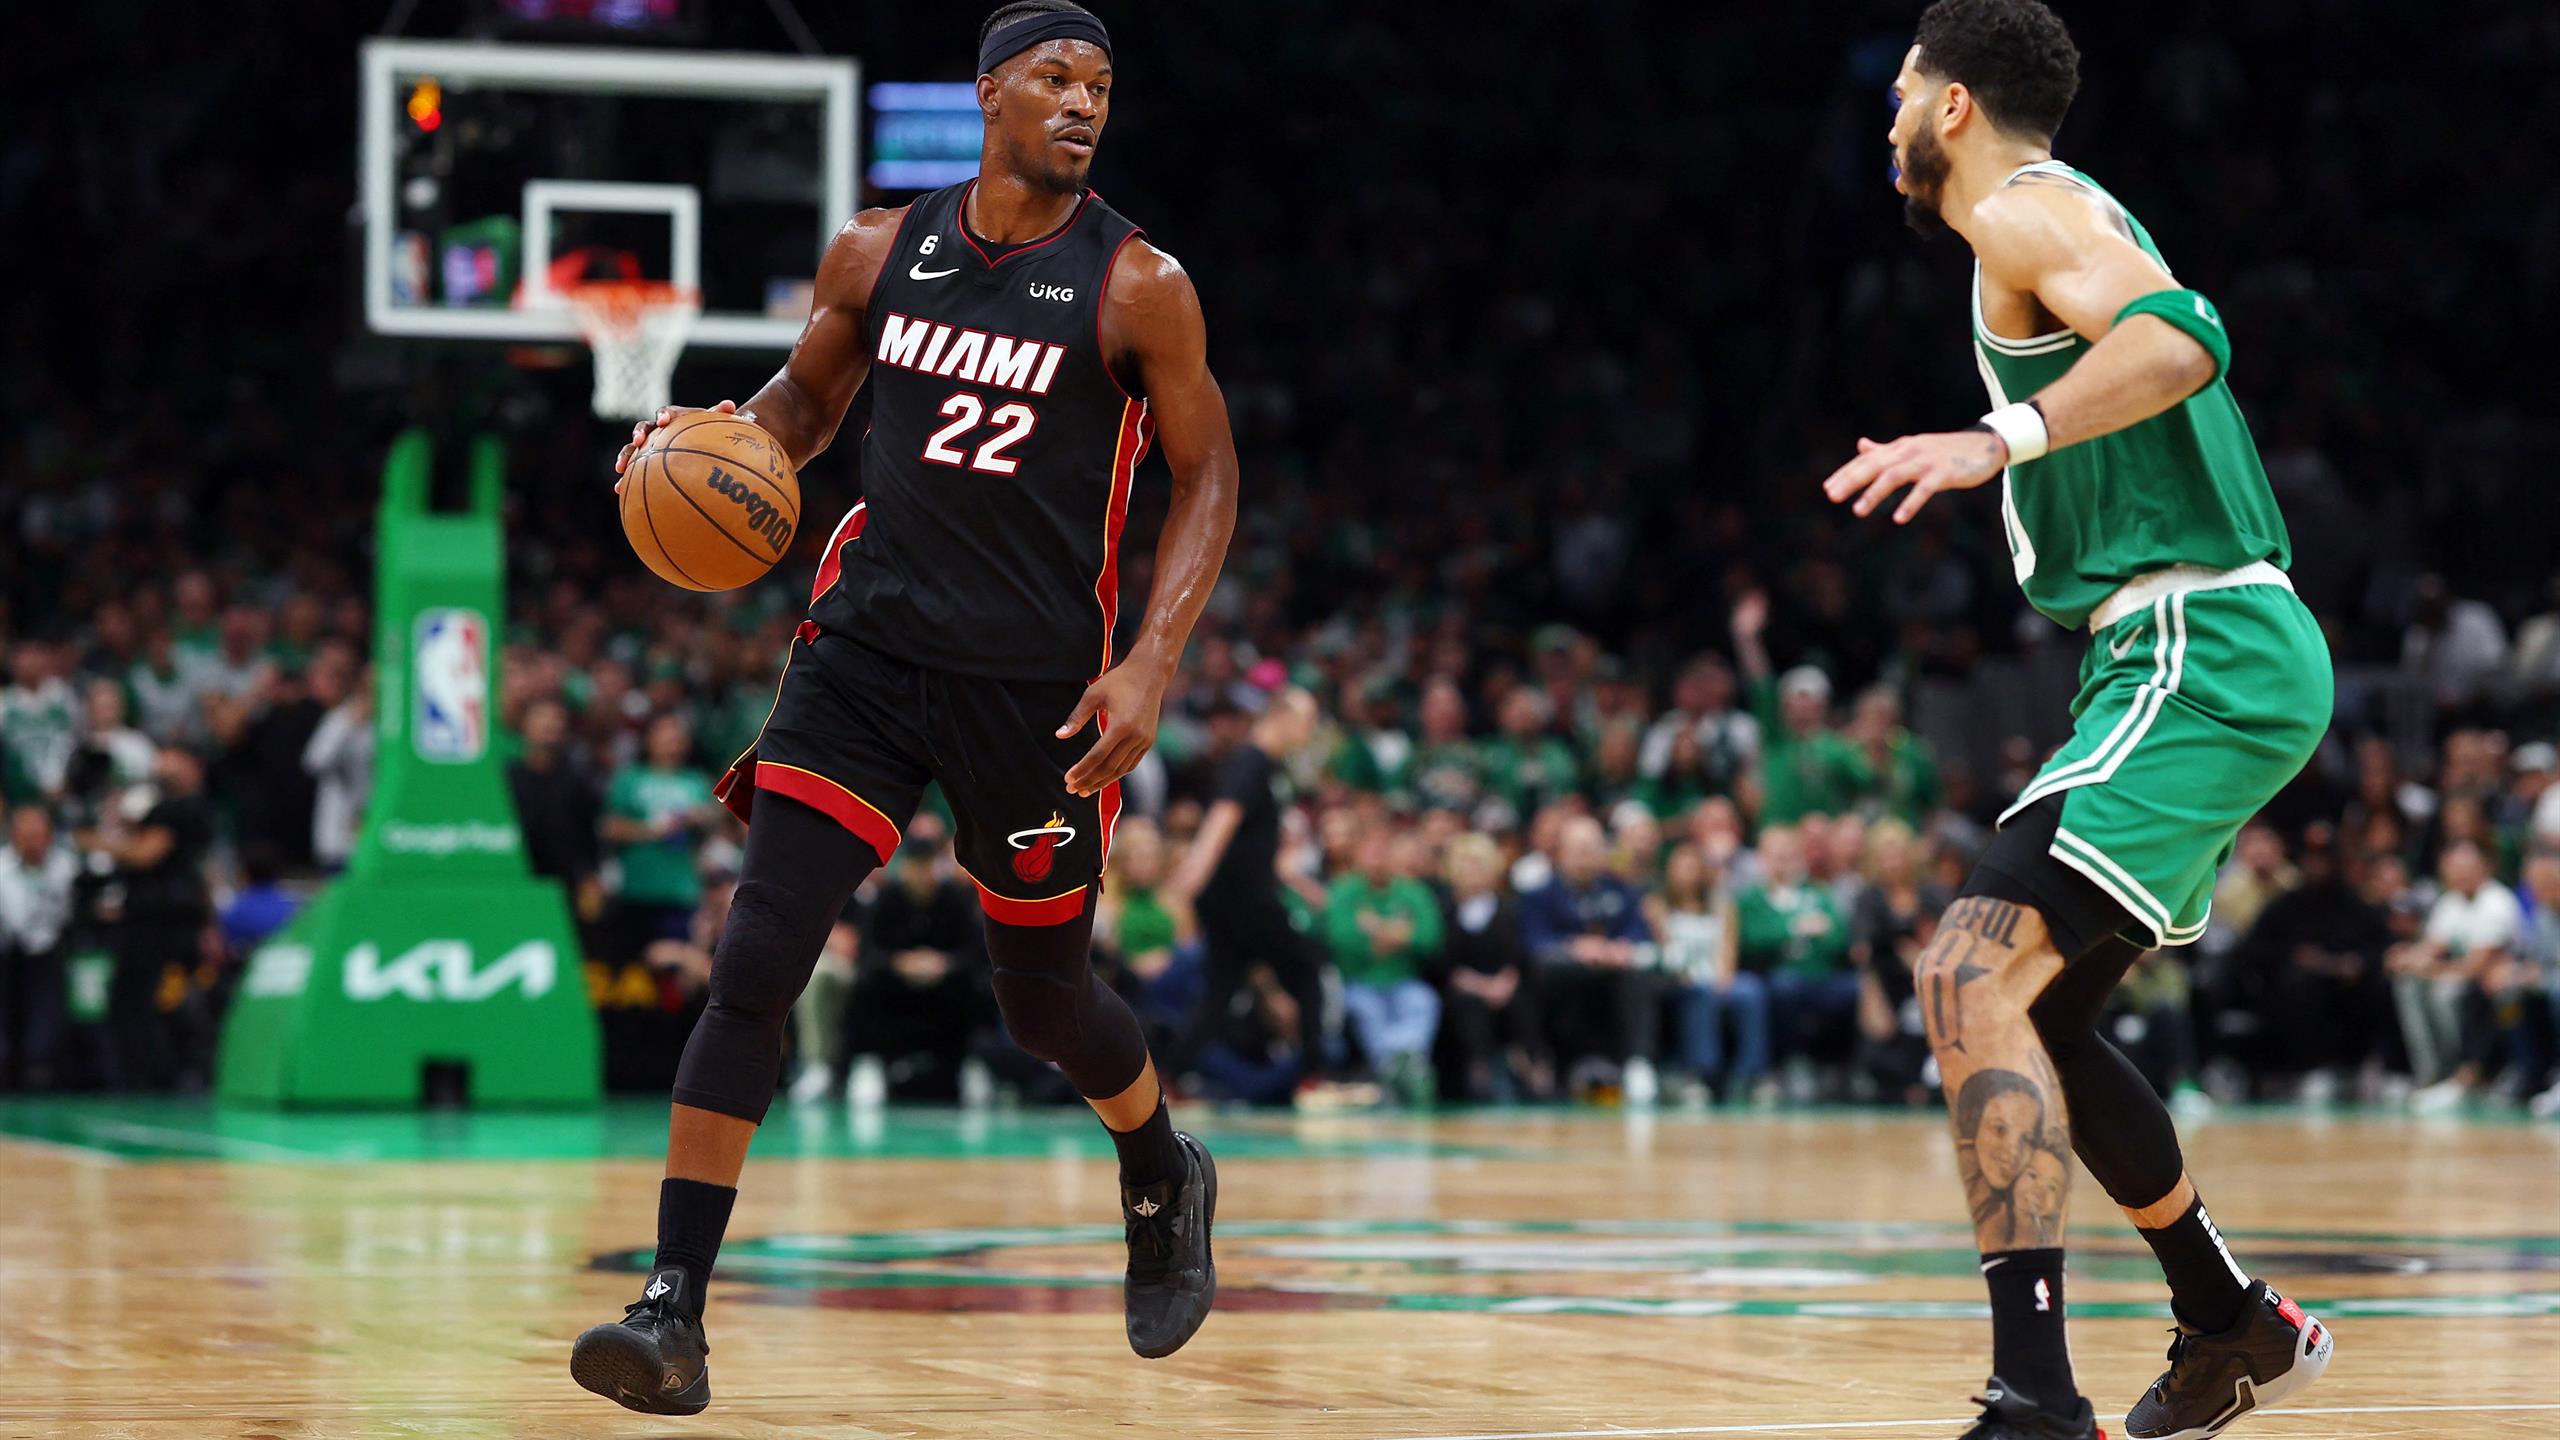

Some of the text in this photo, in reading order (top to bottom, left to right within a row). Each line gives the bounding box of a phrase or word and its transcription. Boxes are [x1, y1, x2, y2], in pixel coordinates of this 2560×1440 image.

[918, 235, 940, 256] 6
[877, 312, 1068, 396] MIAMI
[920, 390, 1039, 477] 22
[707, 466, 792, 556] Wilson
